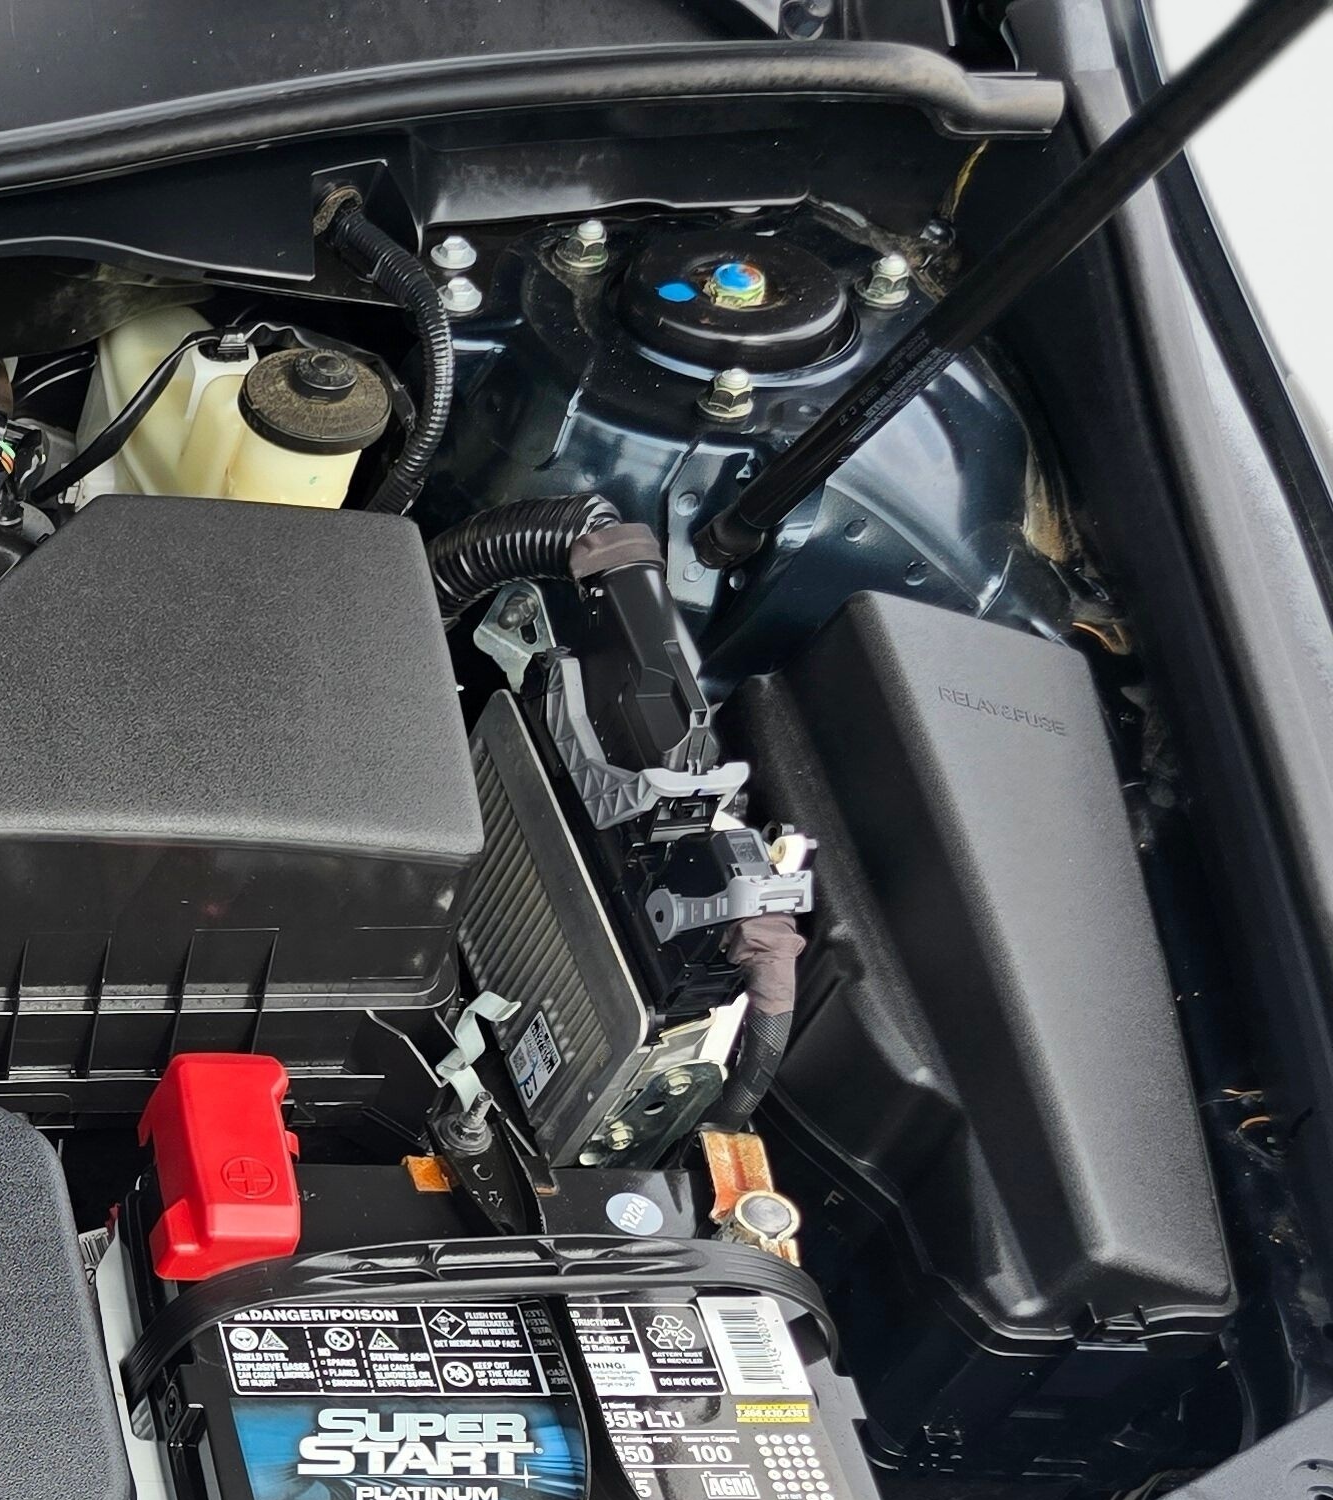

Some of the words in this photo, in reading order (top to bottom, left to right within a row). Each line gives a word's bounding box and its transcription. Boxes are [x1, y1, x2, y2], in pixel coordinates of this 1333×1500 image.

[619, 1197, 649, 1229] 12/24
[248, 1309, 399, 1321] DANGER/POISON
[317, 1409, 527, 1442] SUPER
[297, 1436, 534, 1475] START
[688, 1444, 733, 1463] 100
[356, 1486, 499, 1500] PLATINUM
[709, 1477, 755, 1497] AGM
